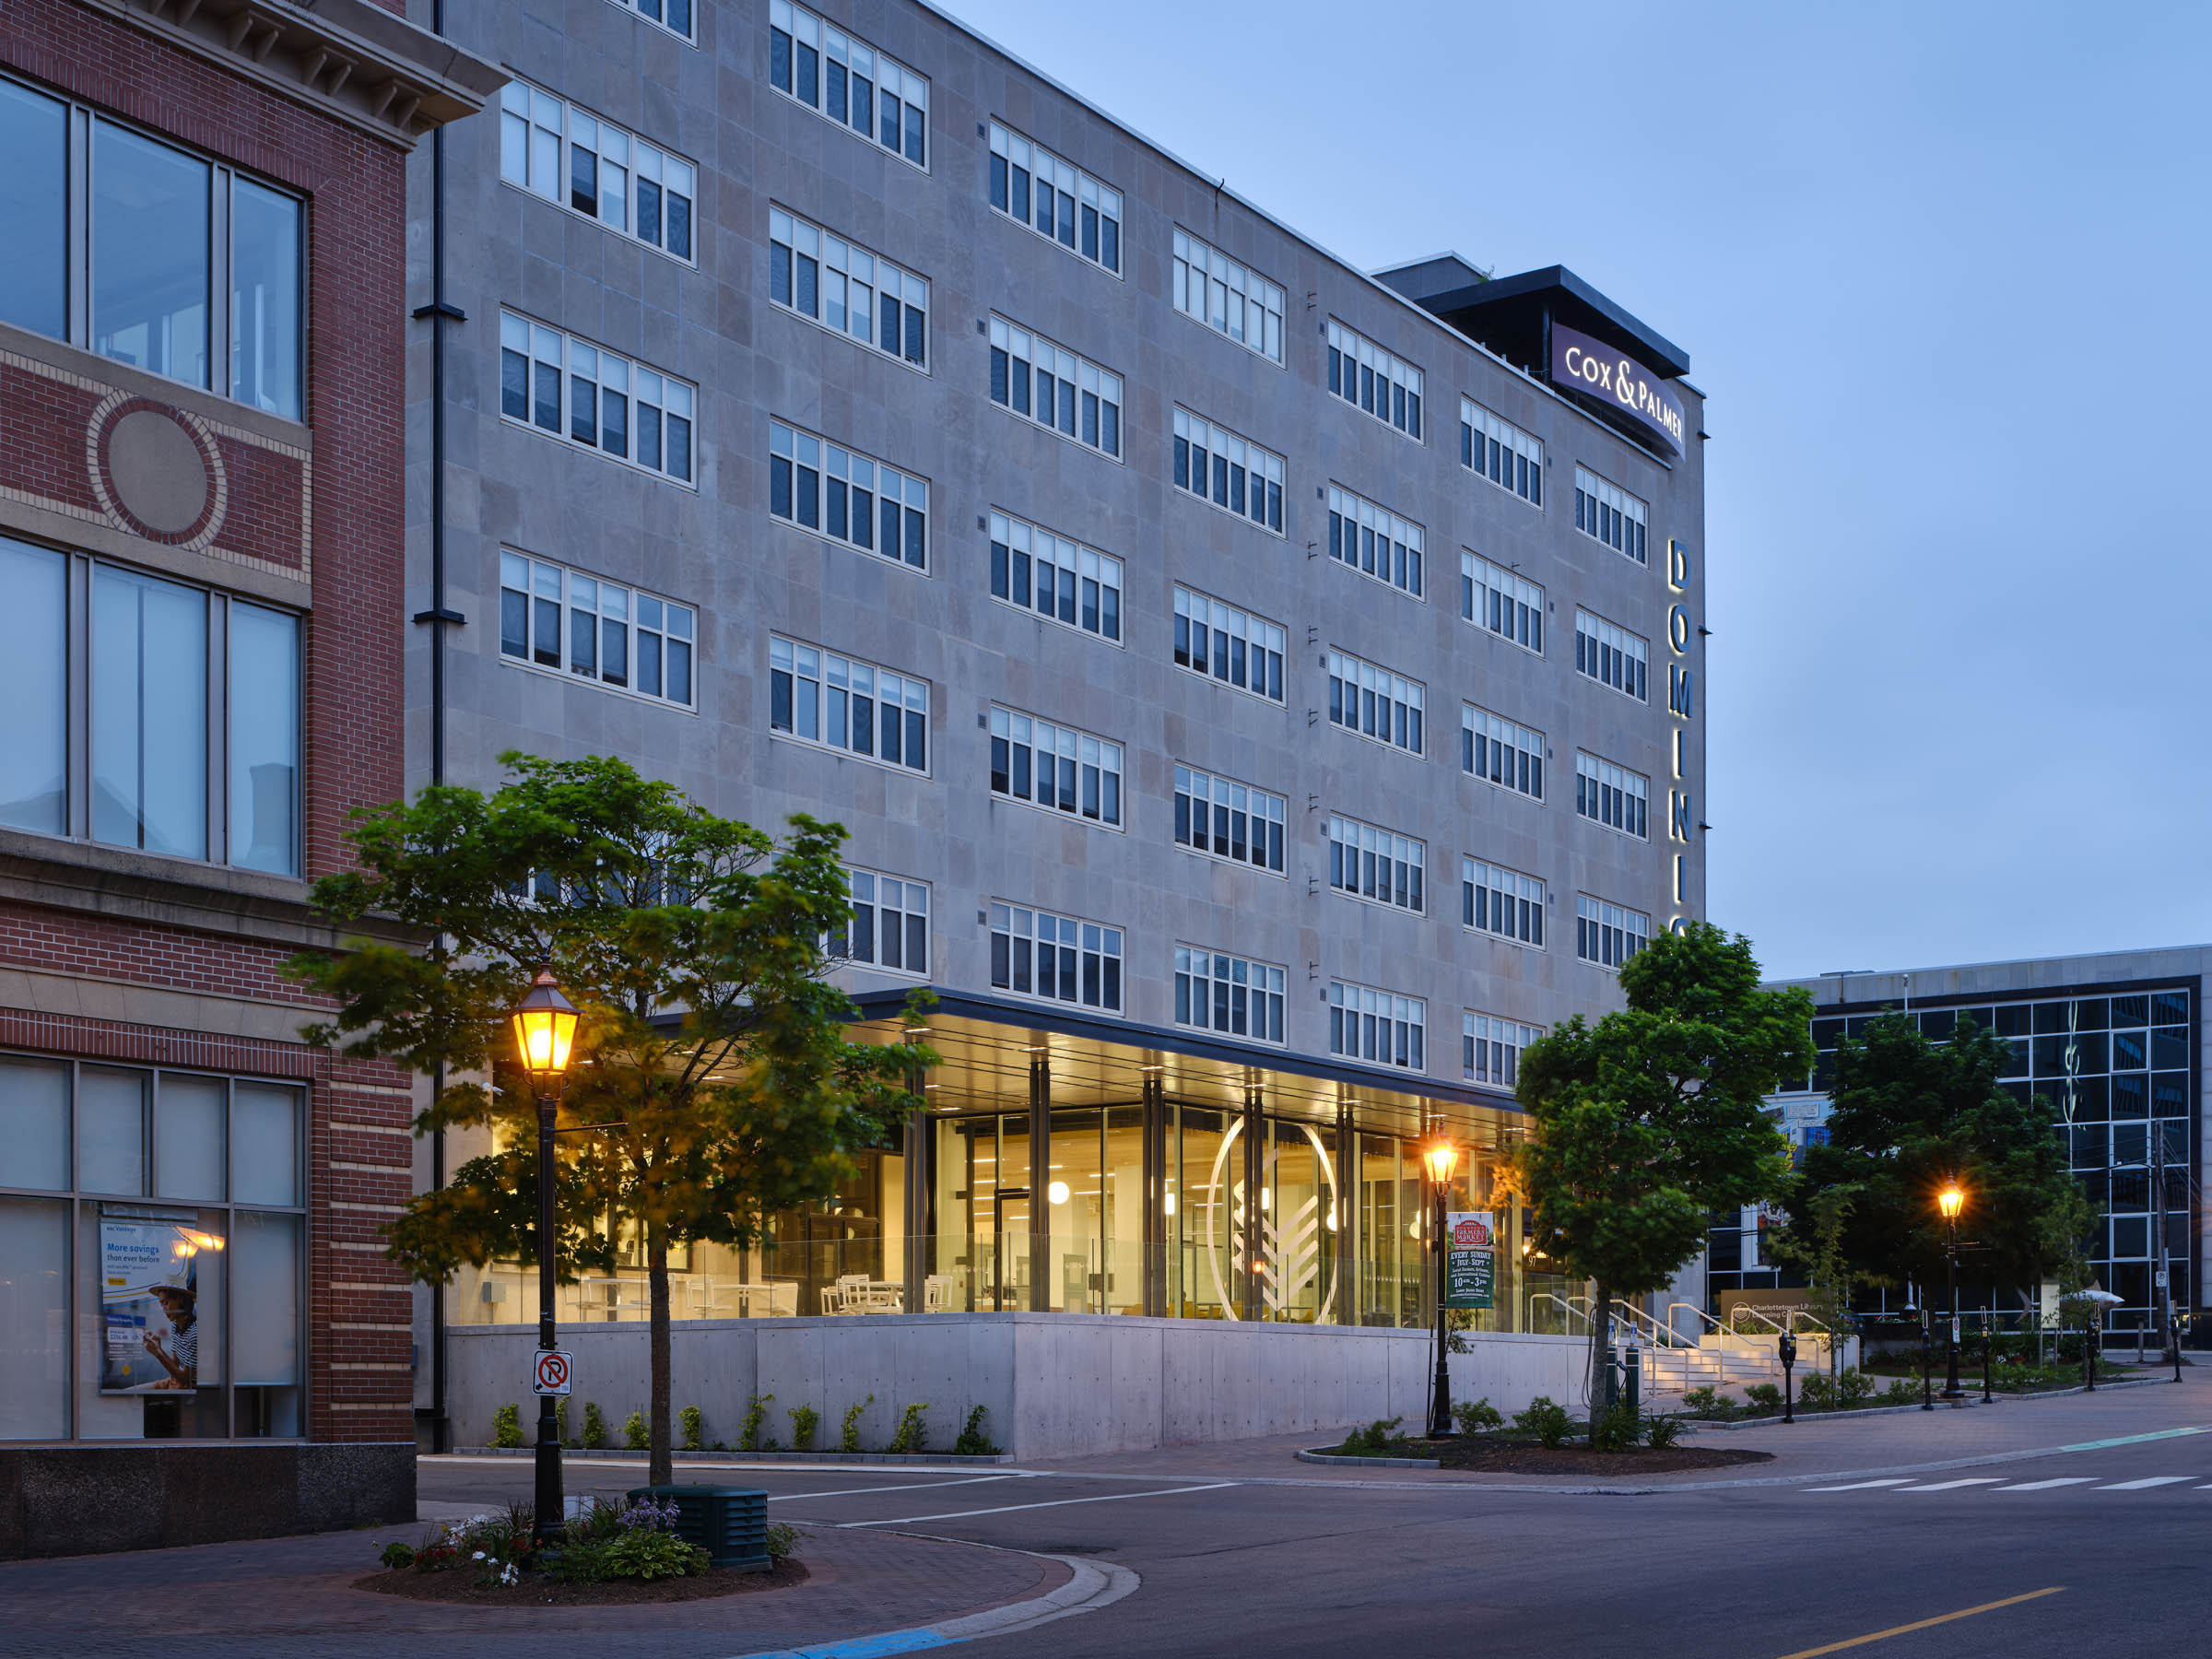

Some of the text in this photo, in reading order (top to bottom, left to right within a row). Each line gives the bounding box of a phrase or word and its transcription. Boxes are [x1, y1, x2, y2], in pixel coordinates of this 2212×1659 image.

[1566, 347, 1682, 444] COX & PALMER
[107, 1242, 159, 1255] More savings
[1528, 1254, 1535, 1267] 97
